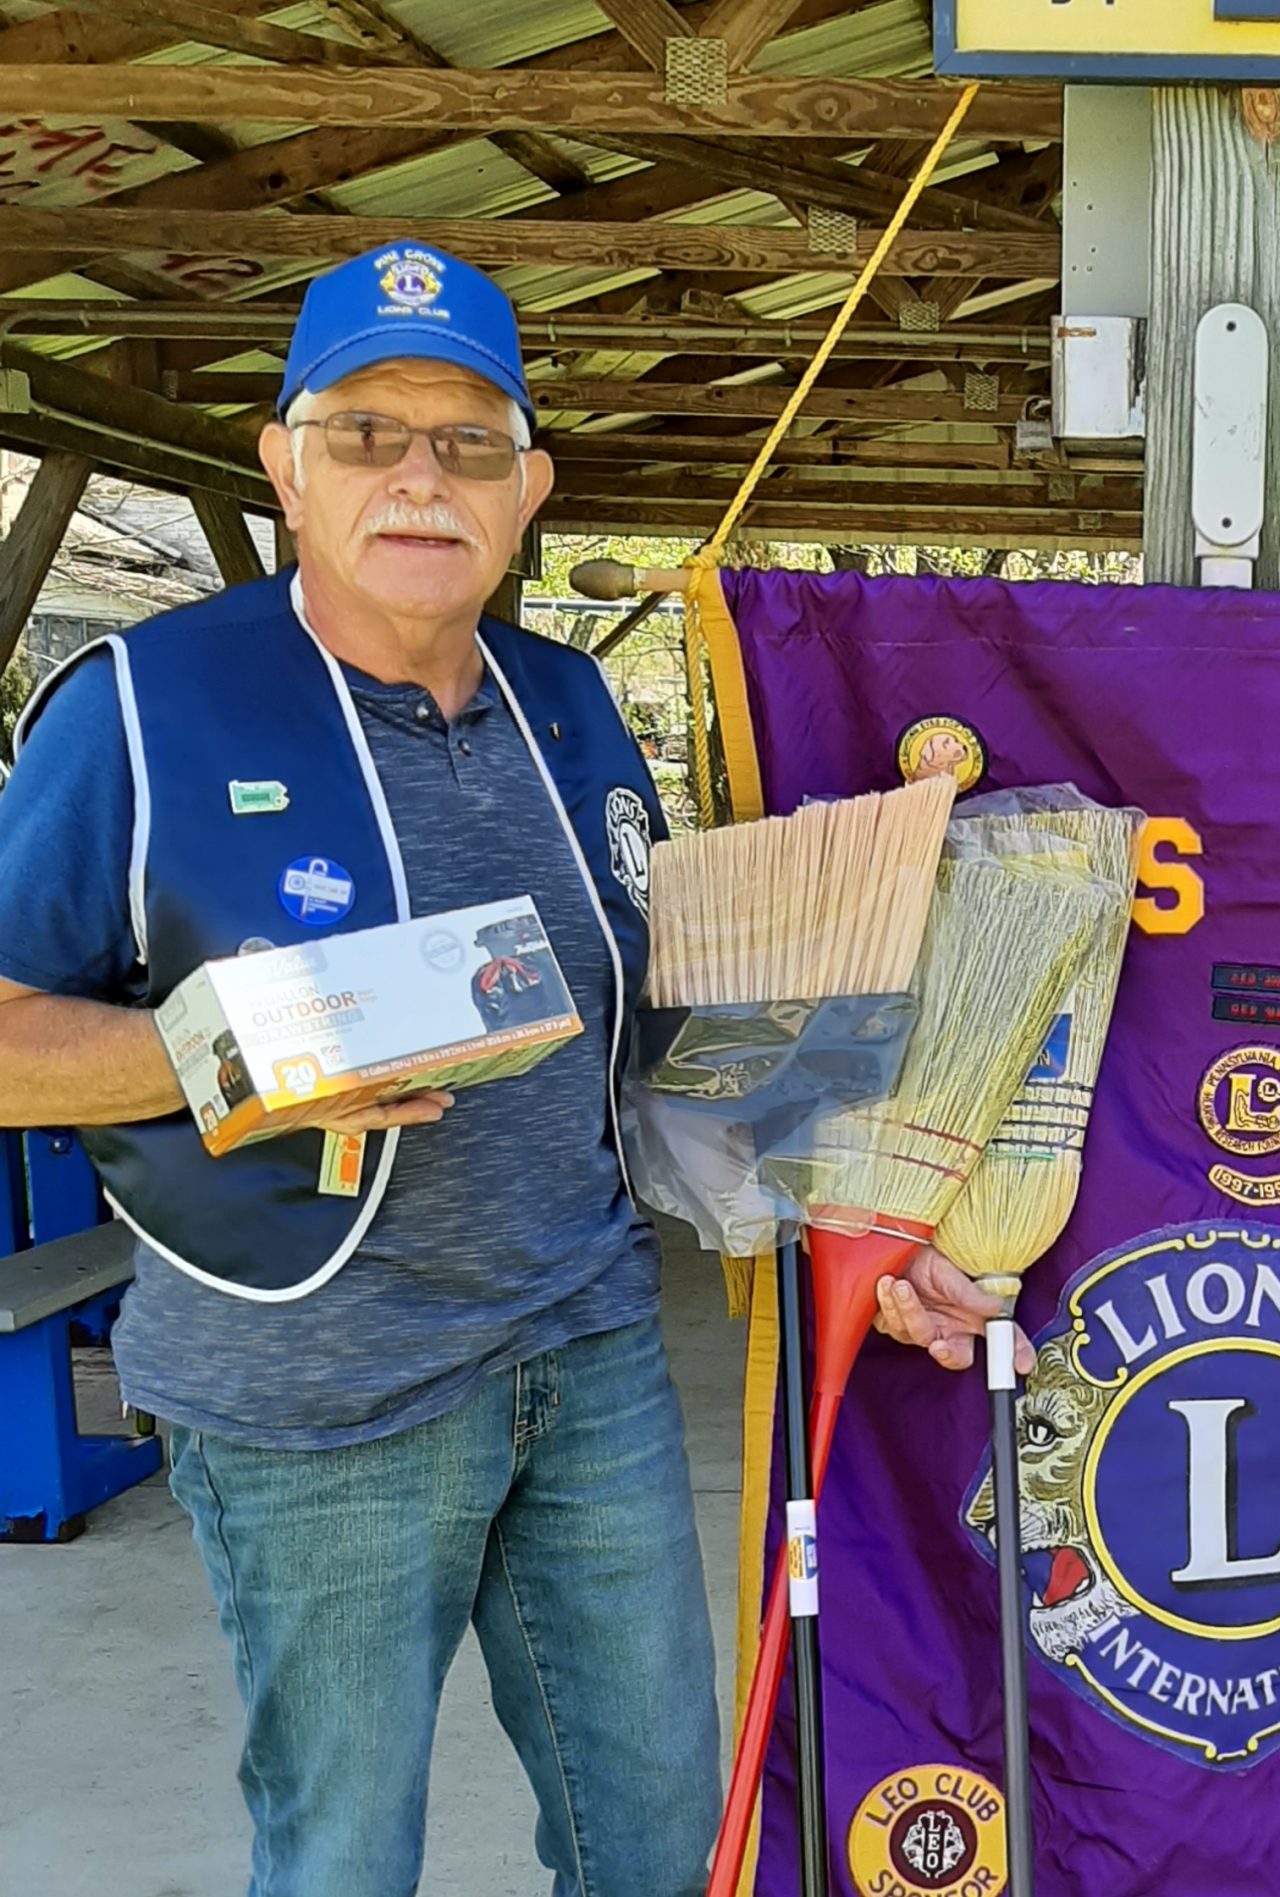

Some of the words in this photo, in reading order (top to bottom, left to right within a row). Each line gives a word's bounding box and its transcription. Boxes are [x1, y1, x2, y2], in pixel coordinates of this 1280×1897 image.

[252, 991, 357, 1027] OUTDOOR
[281, 1061, 317, 1088] 20
[865, 1776, 919, 1828] LEO
[935, 1772, 1000, 1823] CLUB
